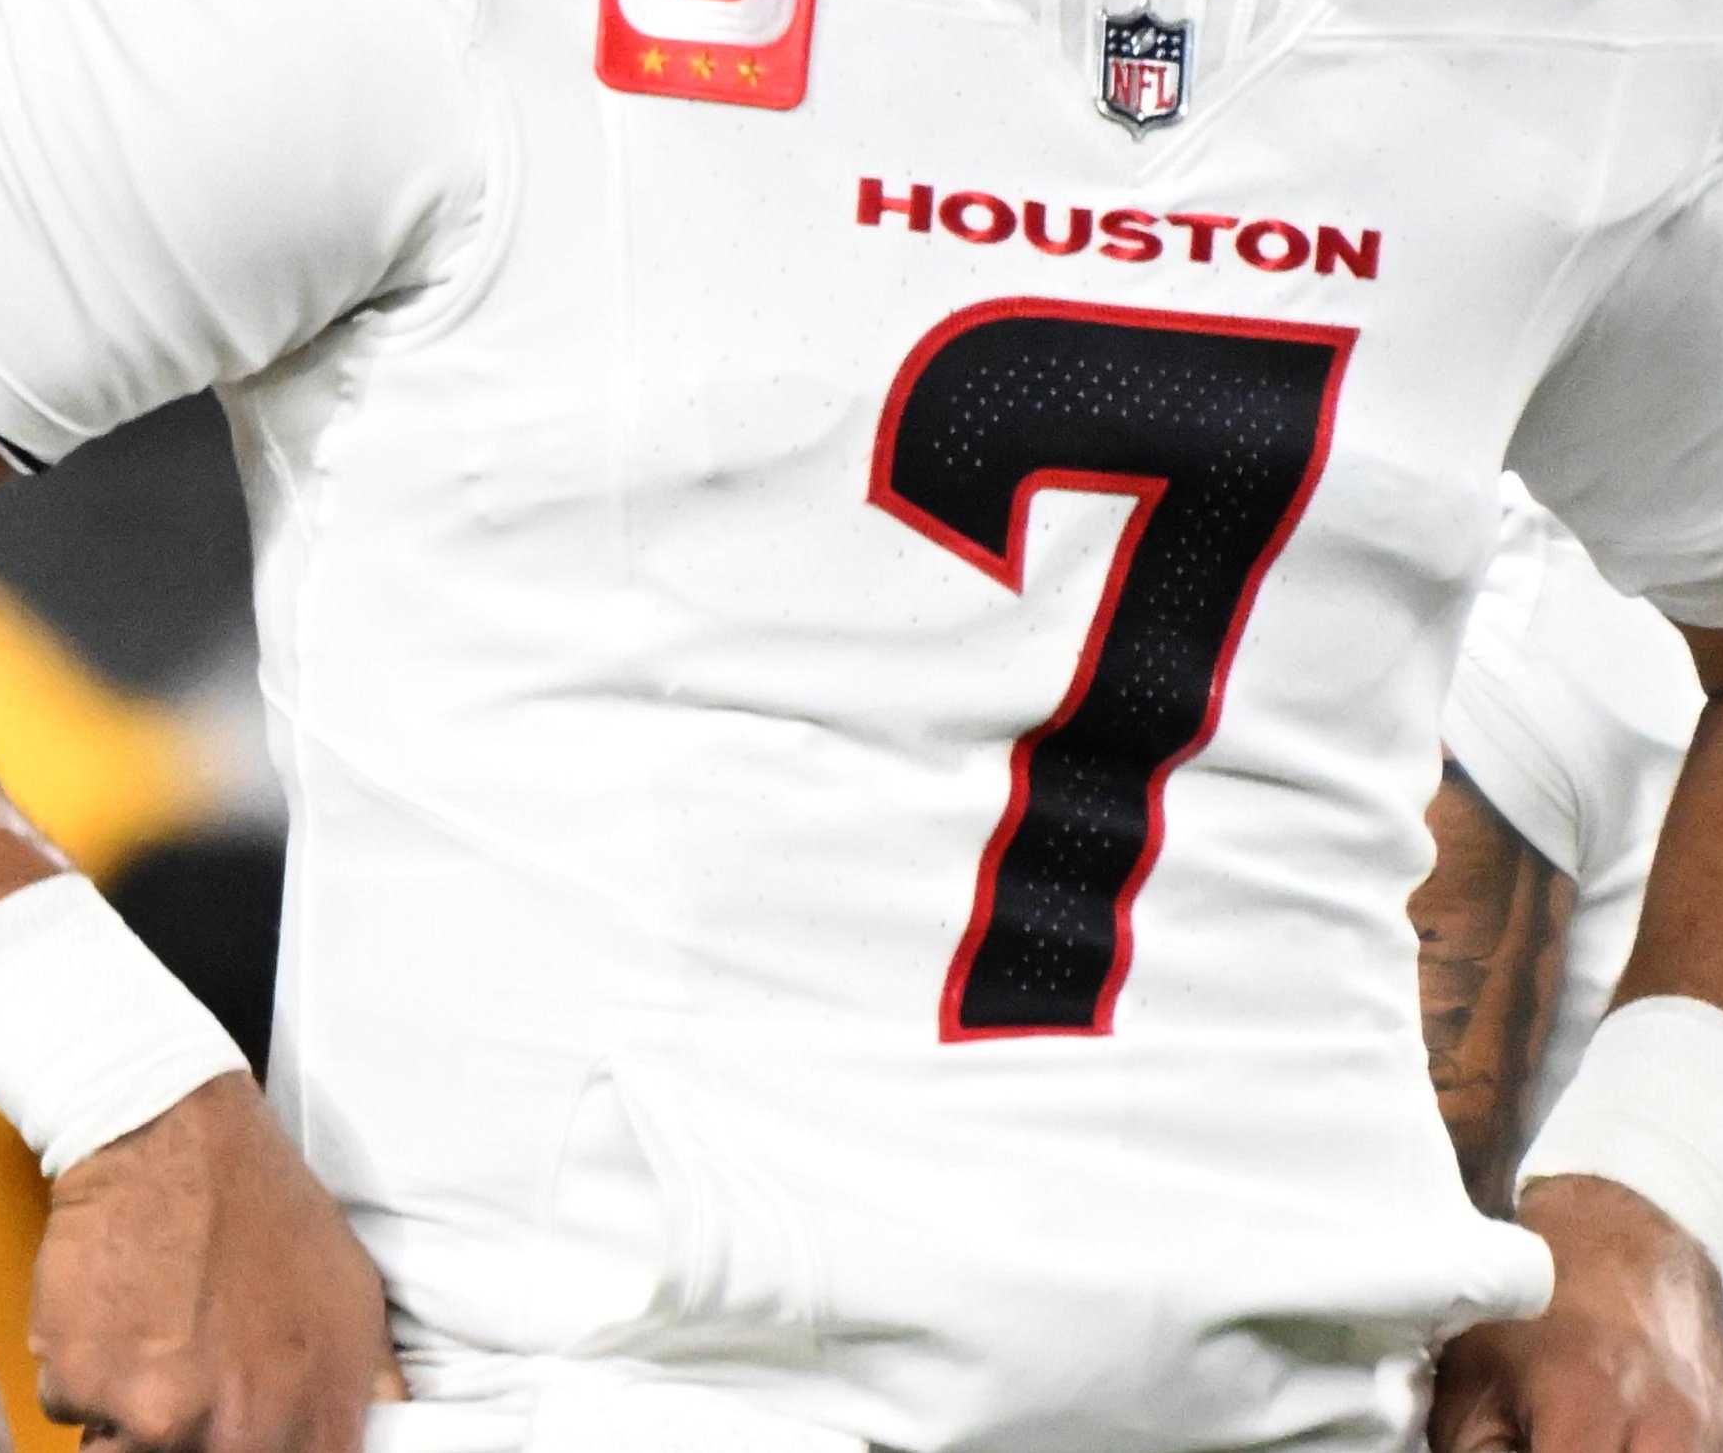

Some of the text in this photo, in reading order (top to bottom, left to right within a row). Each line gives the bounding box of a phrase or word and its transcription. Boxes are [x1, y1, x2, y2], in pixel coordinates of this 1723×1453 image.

[1108, 59, 1175, 113] NFL
[856, 177, 1382, 281] HOUSTON
[864, 294, 1362, 1043] 7
